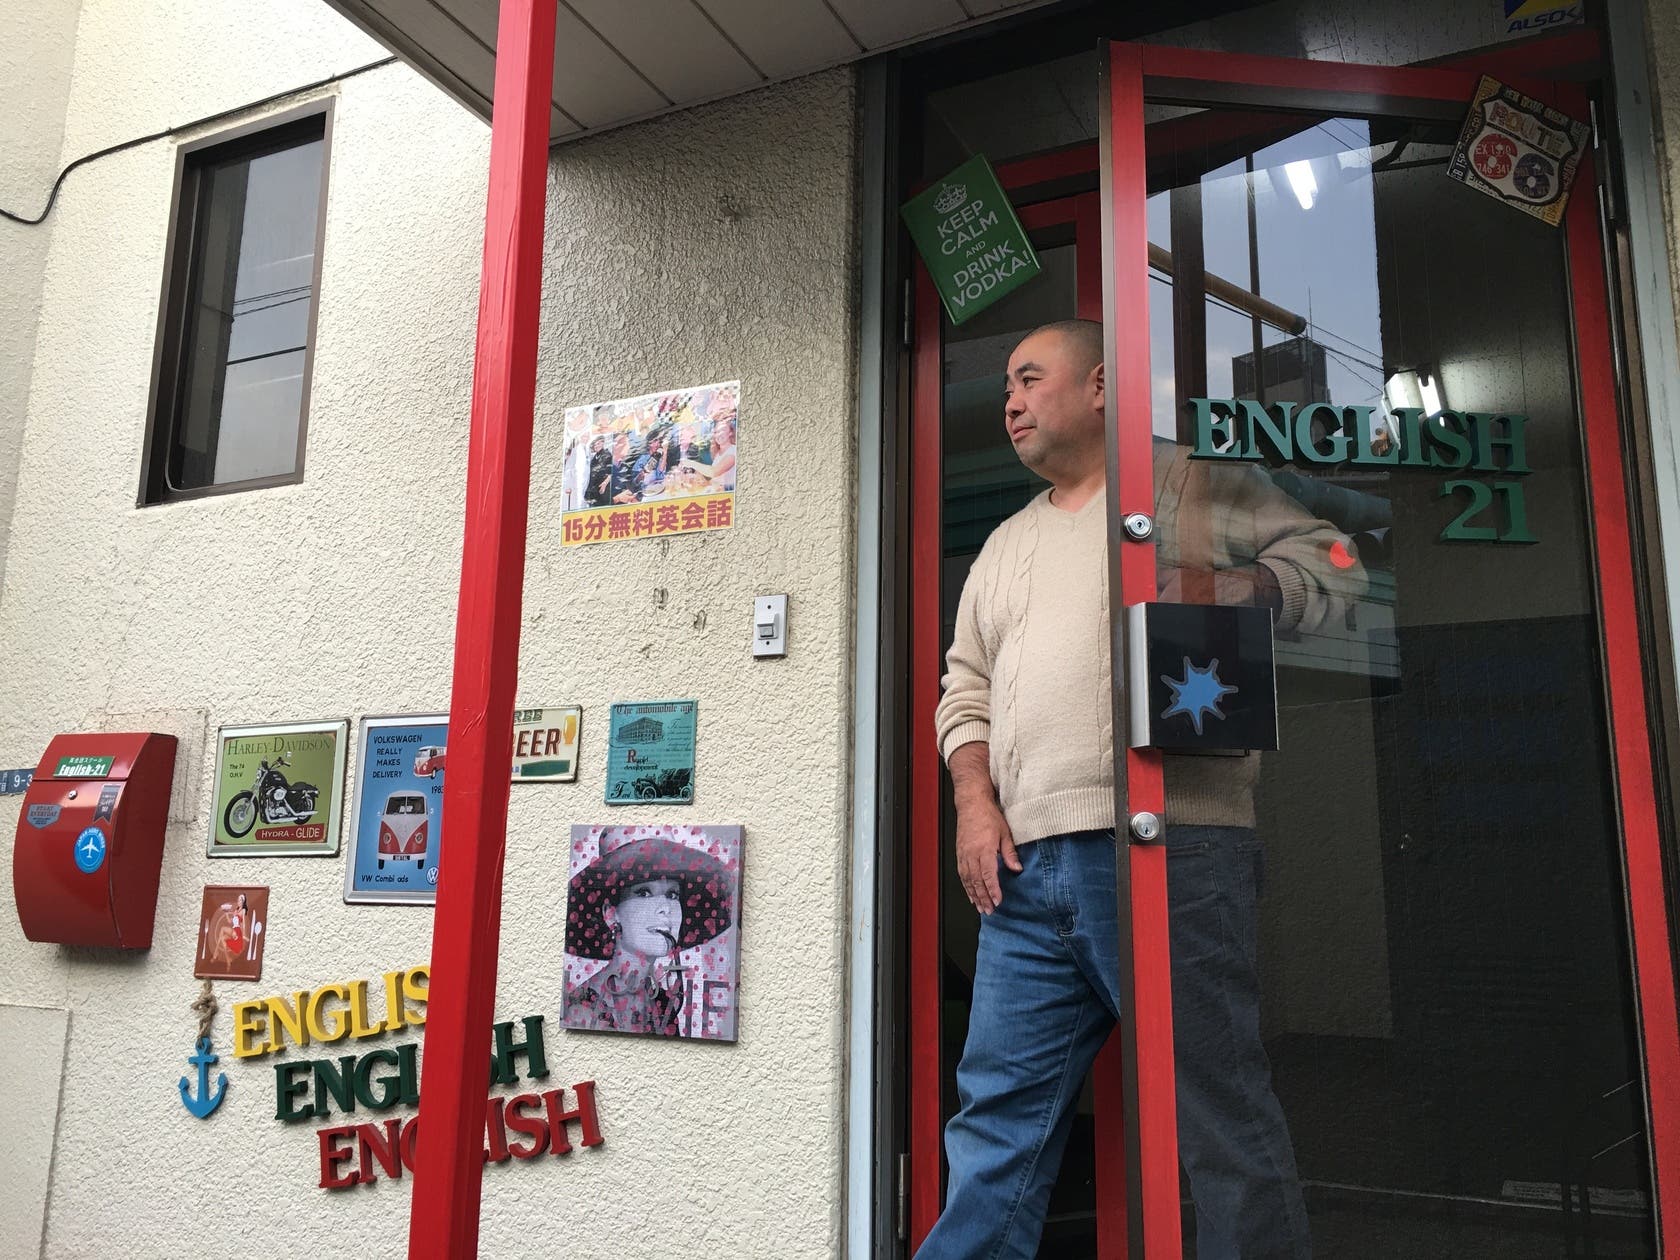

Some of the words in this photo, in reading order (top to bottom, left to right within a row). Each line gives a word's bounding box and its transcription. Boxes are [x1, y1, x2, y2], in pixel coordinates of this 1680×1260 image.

[1490, 102, 1565, 158] ROUTE
[1473, 133, 1555, 199] 66
[937, 200, 984, 238] KEEP
[941, 211, 998, 255] CALM
[953, 240, 1014, 288] DRINK
[965, 240, 986, 258] AND
[952, 250, 1031, 307] VODKA!
[1187, 397, 1534, 476] ENGLISH
[563, 498, 732, 542] 15分無料英会話
[1439, 480, 1540, 545] 21
[373, 735, 422, 744] VOLKSWAGEN
[513, 728, 562, 758] EER
[58, 764, 105, 777] English-21
[372, 770, 403, 778] DELIVERY
[376, 759, 401, 767] MAKES
[261, 829, 289, 838] HYDRA
[296, 828, 320, 838] GLIDE
[397, 875, 409, 883] ads
[232, 965, 431, 1059] ENGLIS
